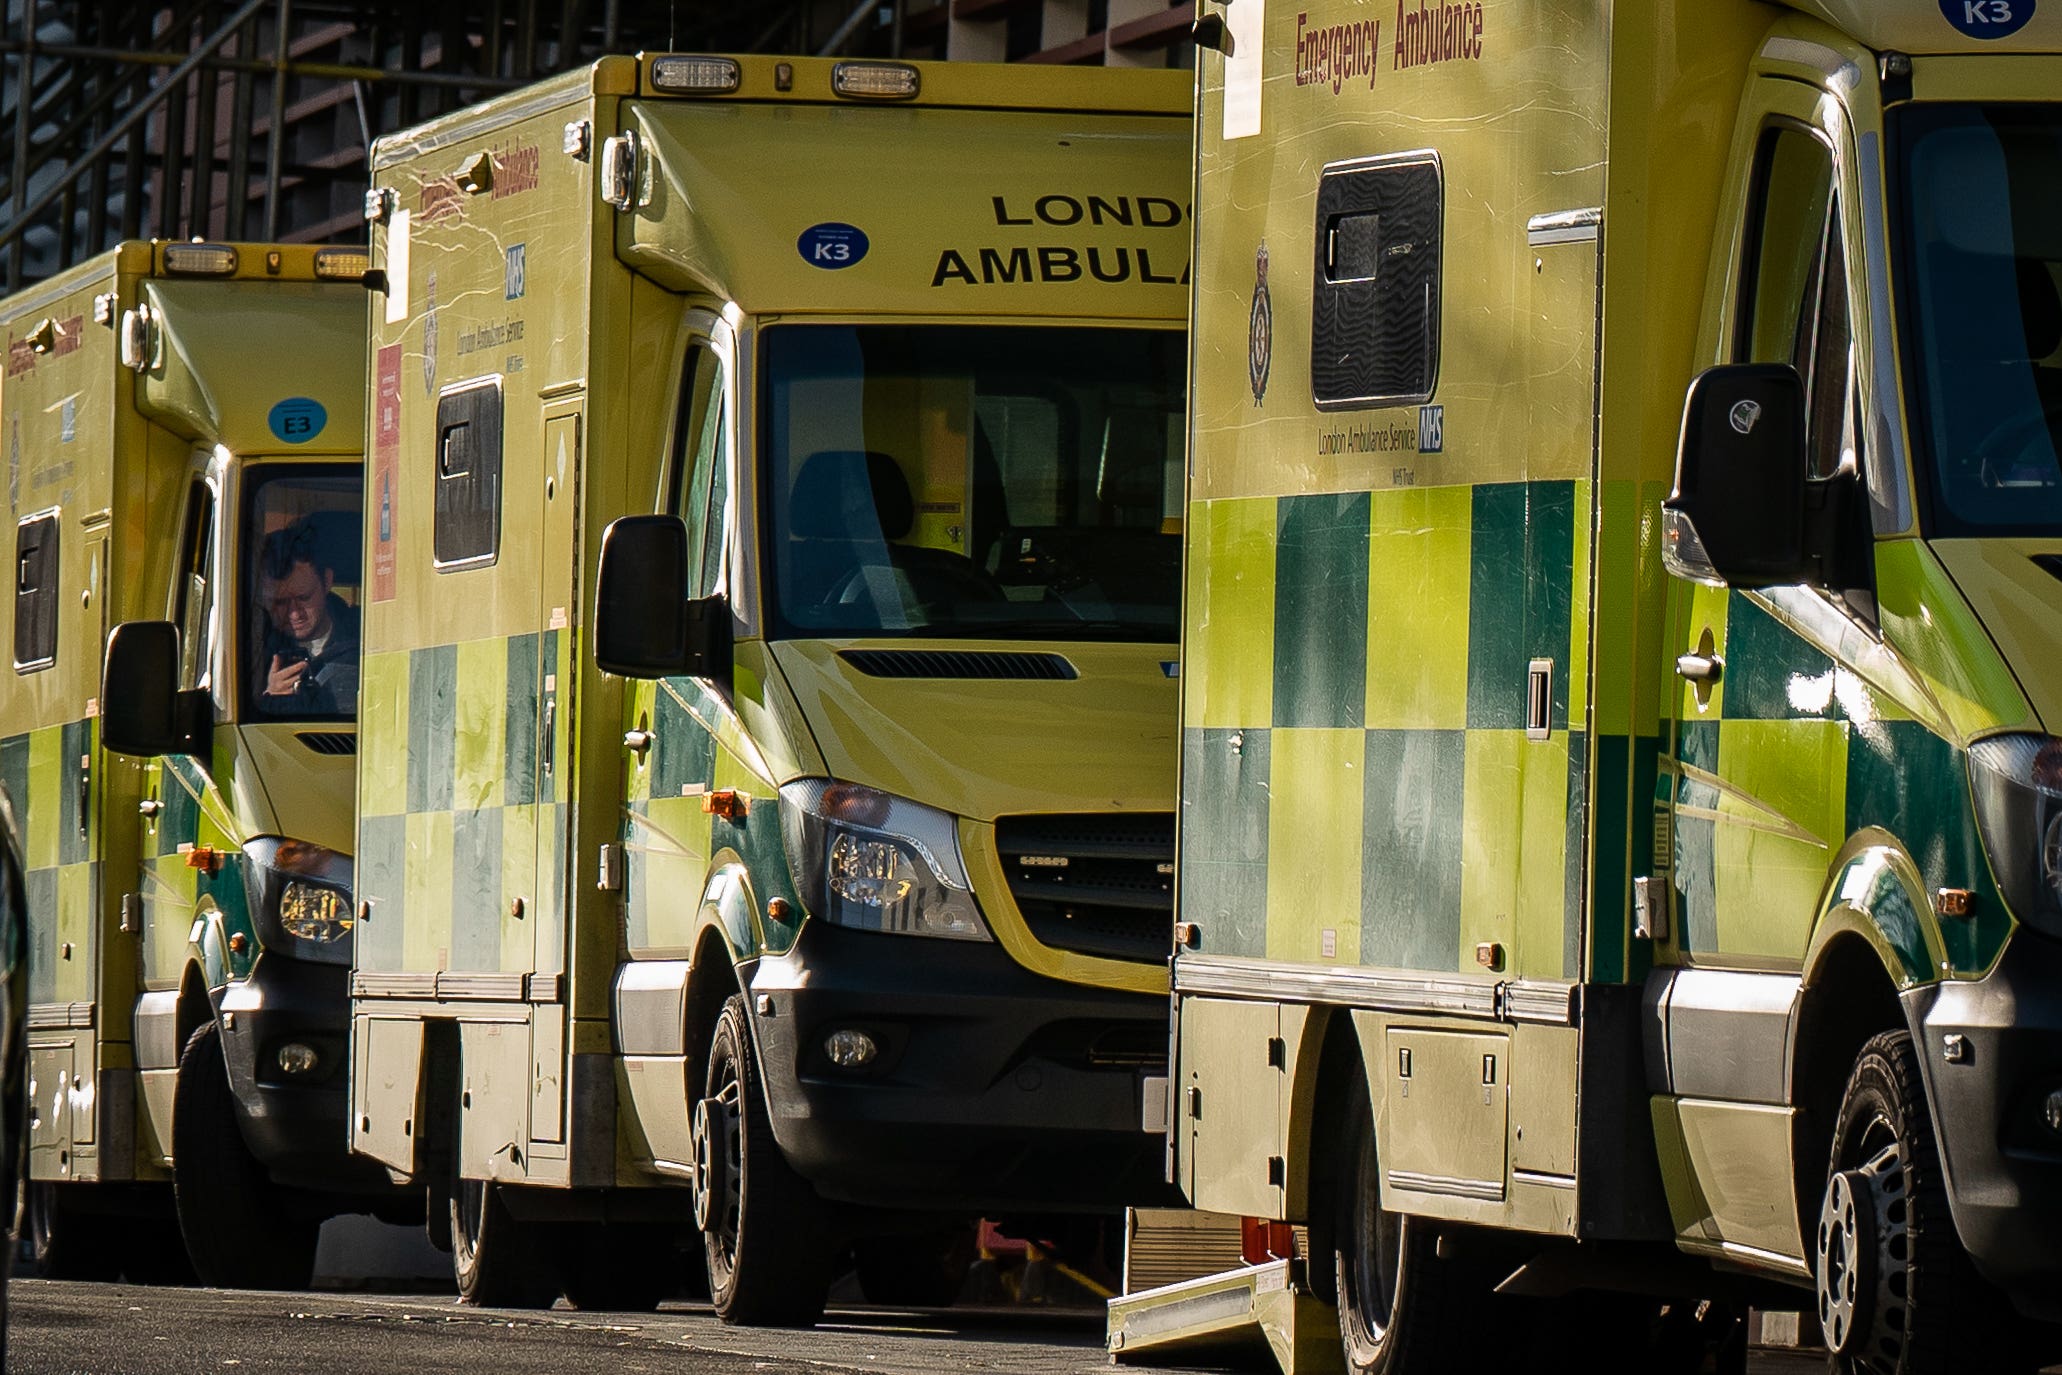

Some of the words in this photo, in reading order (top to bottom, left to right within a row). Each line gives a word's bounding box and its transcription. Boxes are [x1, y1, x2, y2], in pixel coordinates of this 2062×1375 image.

[1963, 0, 2013, 24] K3
[1295, 12, 1380, 95] Emergency
[1394, 0, 1483, 70] Ambulance
[991, 195, 1191, 229] LOND
[815, 243, 850, 260] K3
[930, 246, 1191, 288] AMBUL
[284, 416, 311, 434] E3
[1318, 425, 1346, 455] London
[1347, 423, 1388, 454] Ambulance
[1389, 421, 1416, 451] Service
[1418, 406, 1443, 452] NHS
